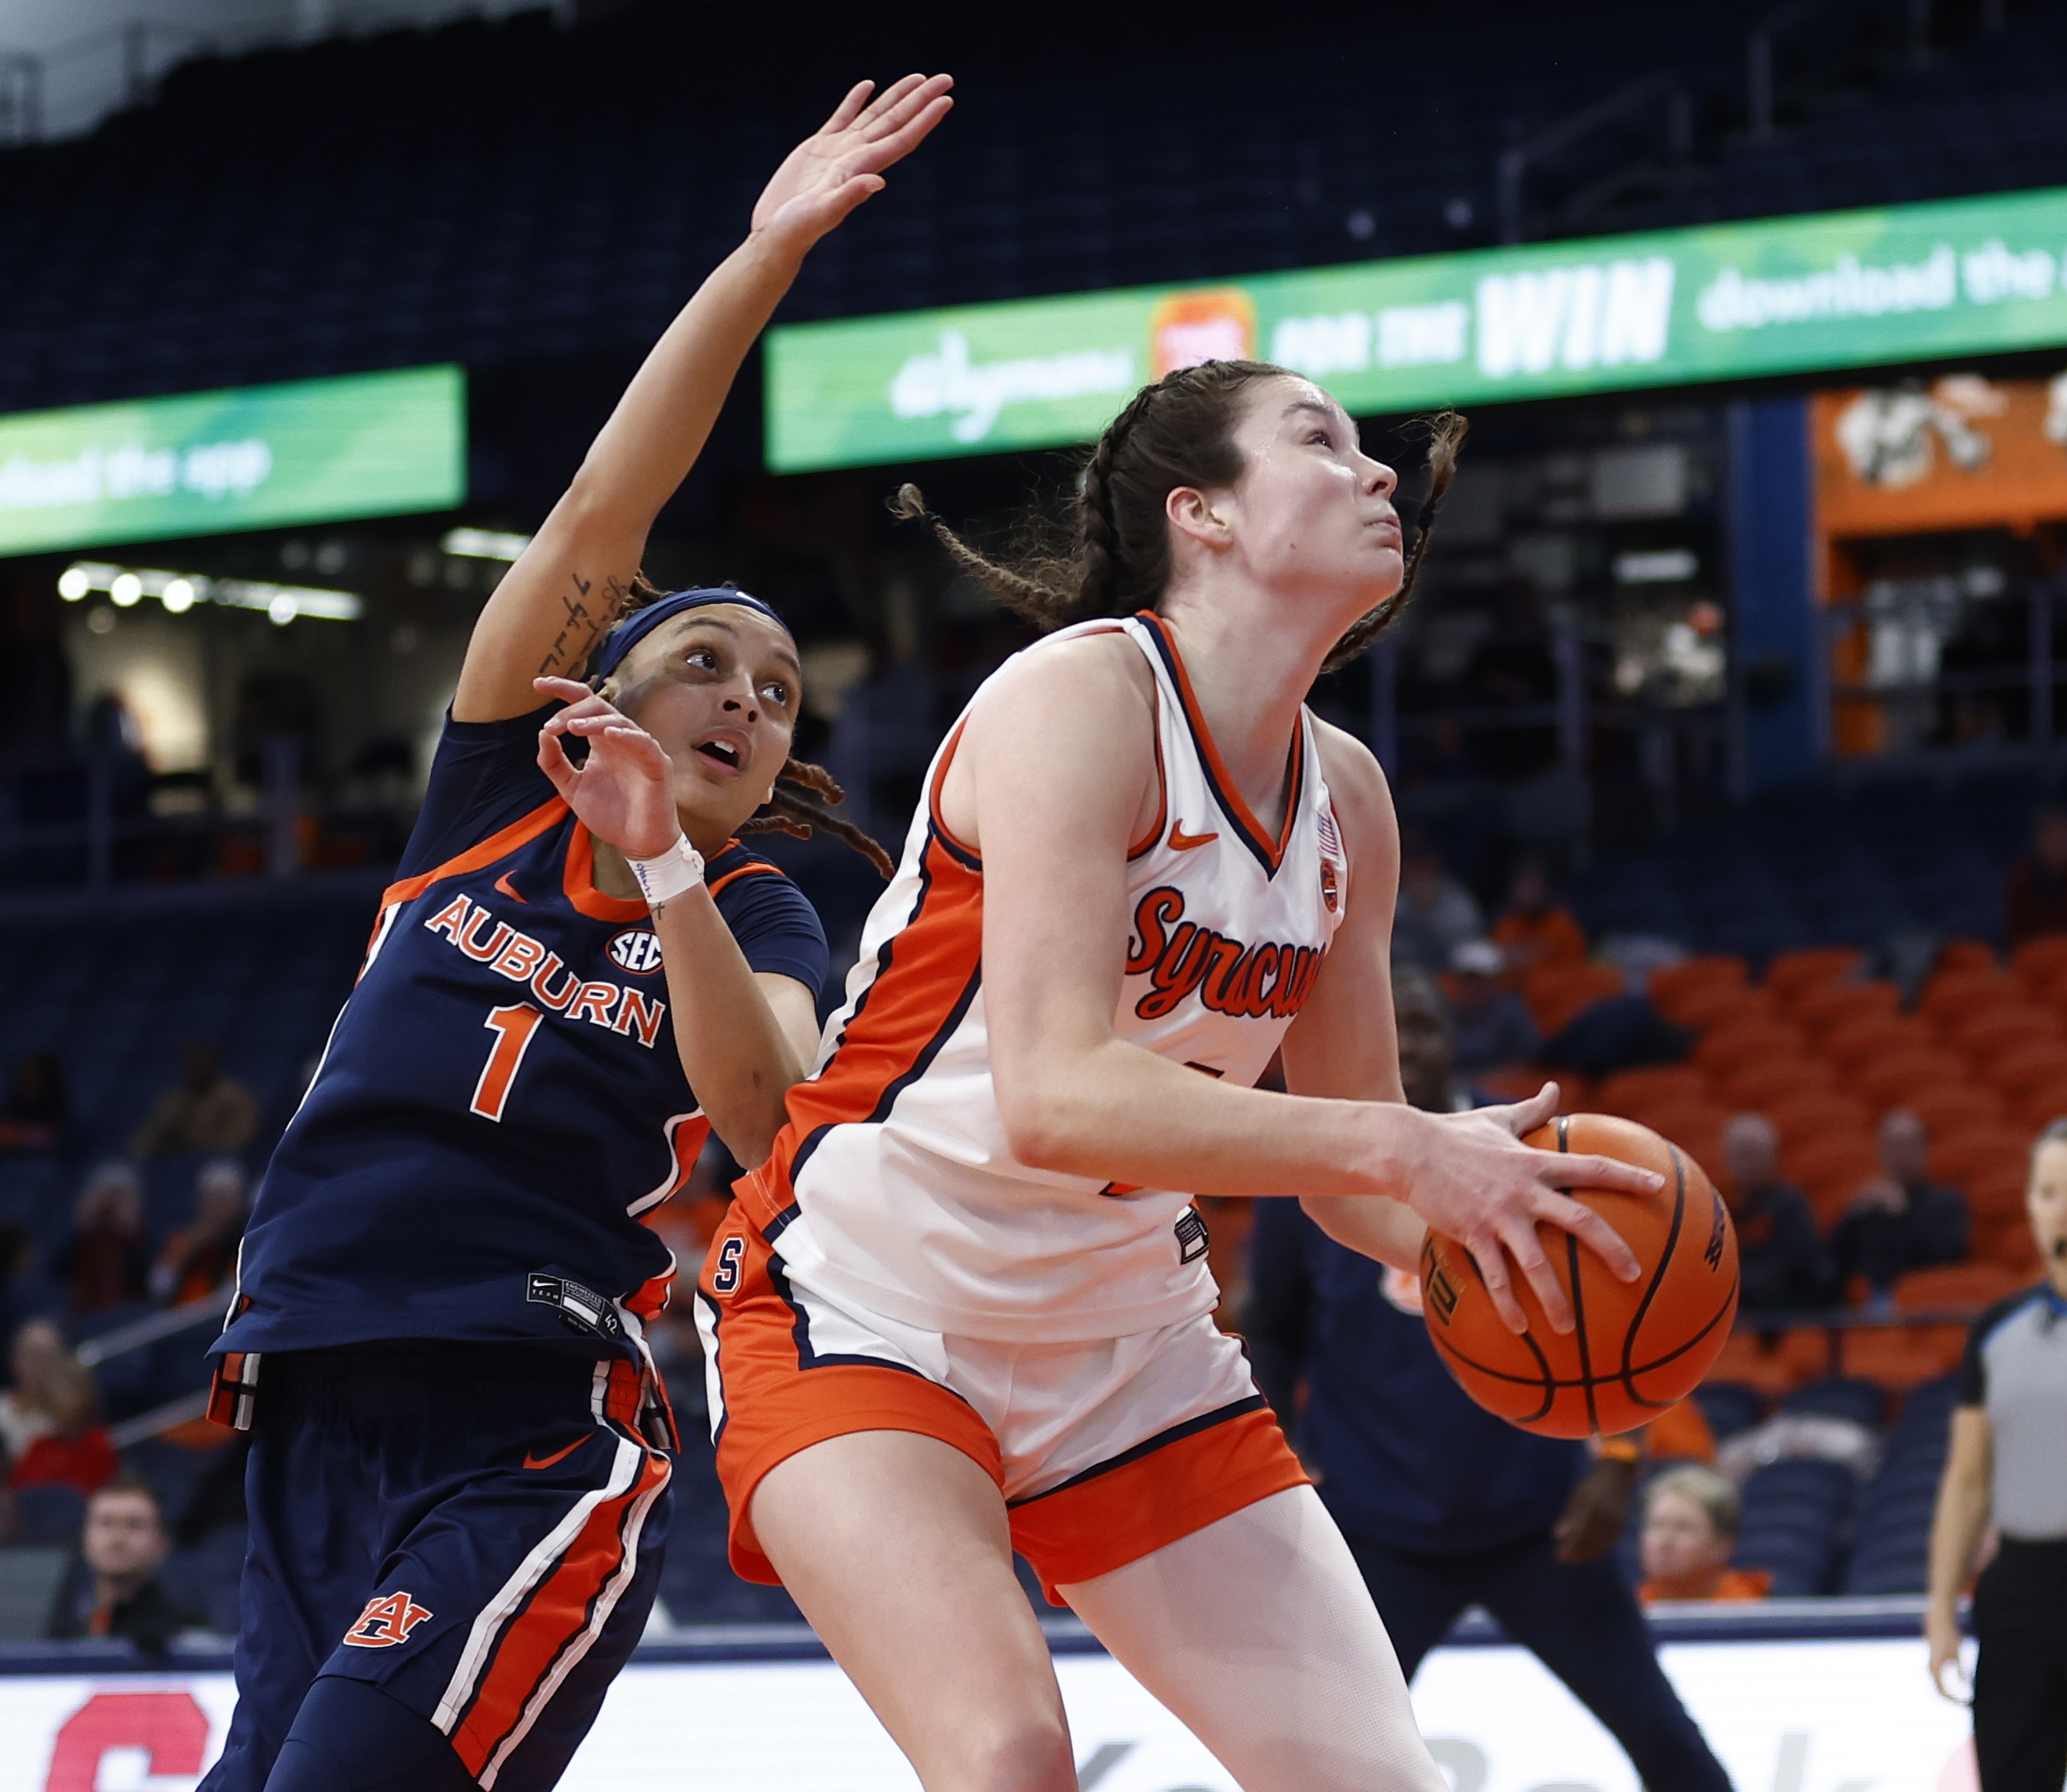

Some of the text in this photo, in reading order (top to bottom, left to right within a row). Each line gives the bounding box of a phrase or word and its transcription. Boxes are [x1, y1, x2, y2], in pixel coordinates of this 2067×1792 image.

[1479, 260, 1674, 377] WIN
[425, 894, 667, 1049] AUBURN
[611, 931, 662, 972] SEC
[469, 1000, 545, 1123] 1
[713, 1237, 744, 1293] S
[532, 1288, 560, 1301] TEAM
[604, 1314, 618, 1335] 42
